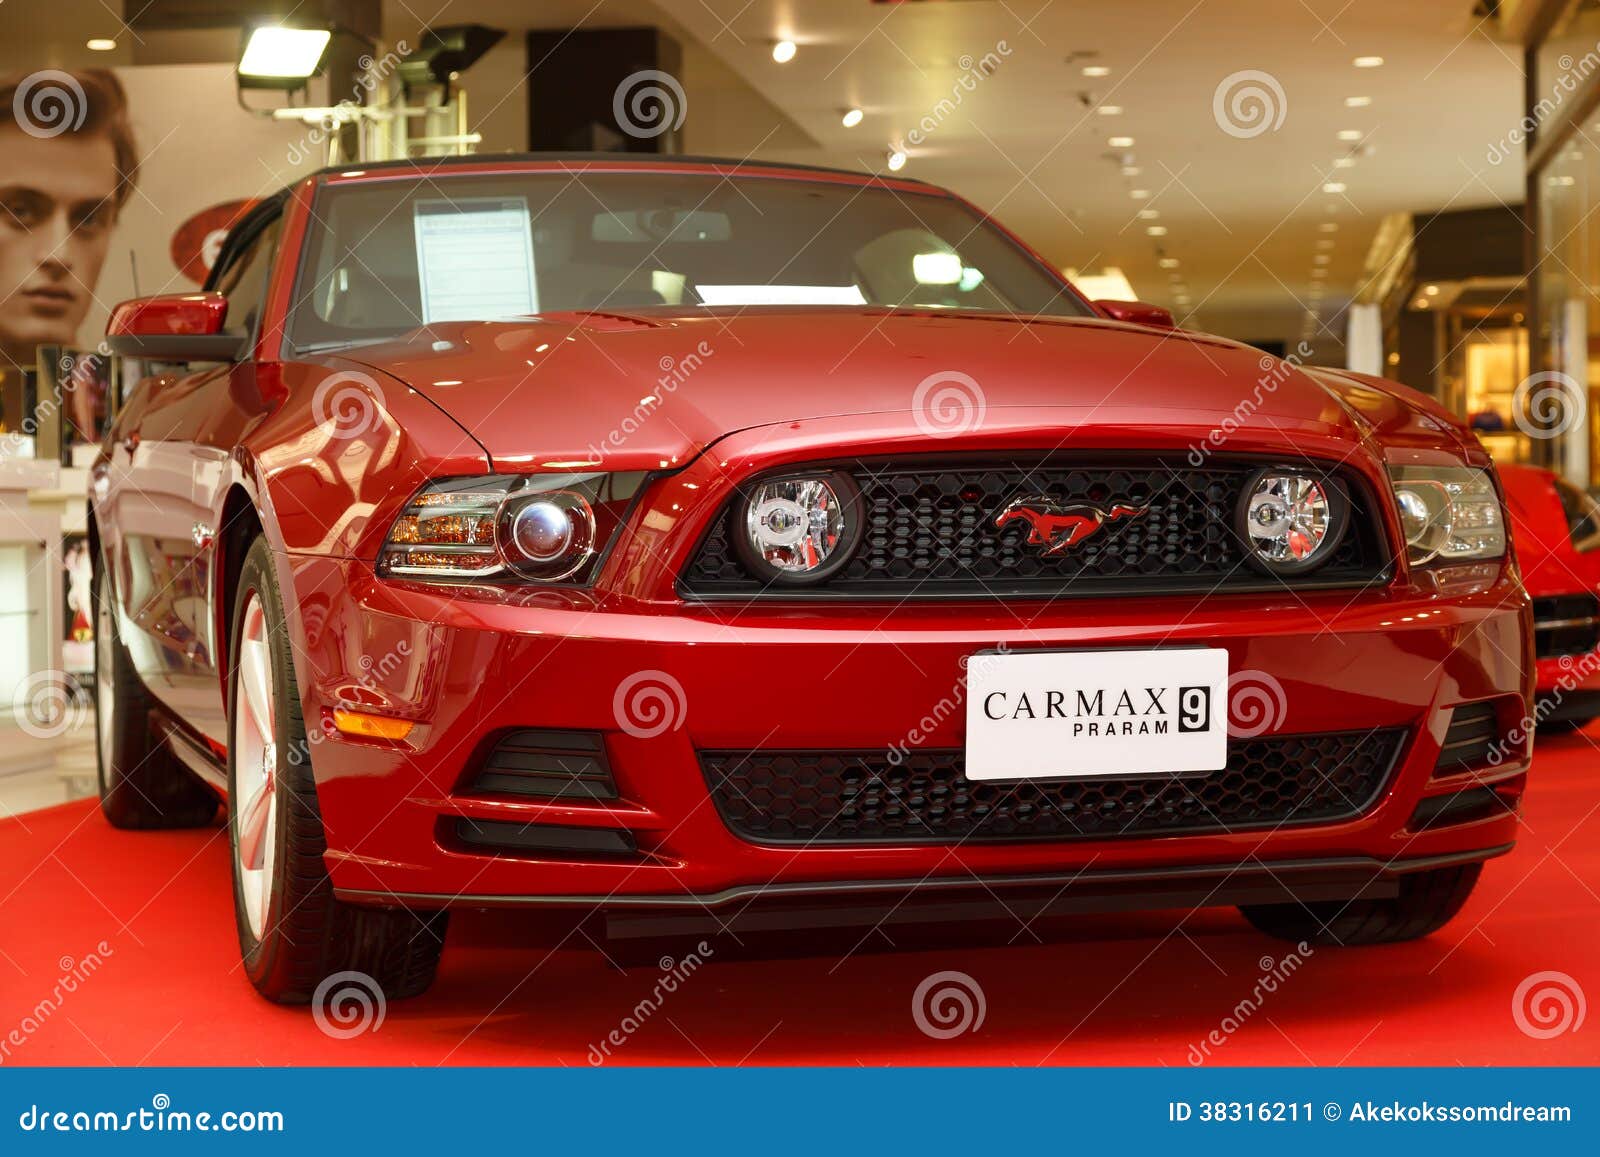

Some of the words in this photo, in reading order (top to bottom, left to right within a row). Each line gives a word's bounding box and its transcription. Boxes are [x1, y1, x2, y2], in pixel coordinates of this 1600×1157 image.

[983, 687, 1168, 720] CARMAX
[1180, 687, 1209, 731] 9
[1073, 720, 1168, 737] PRARAM
